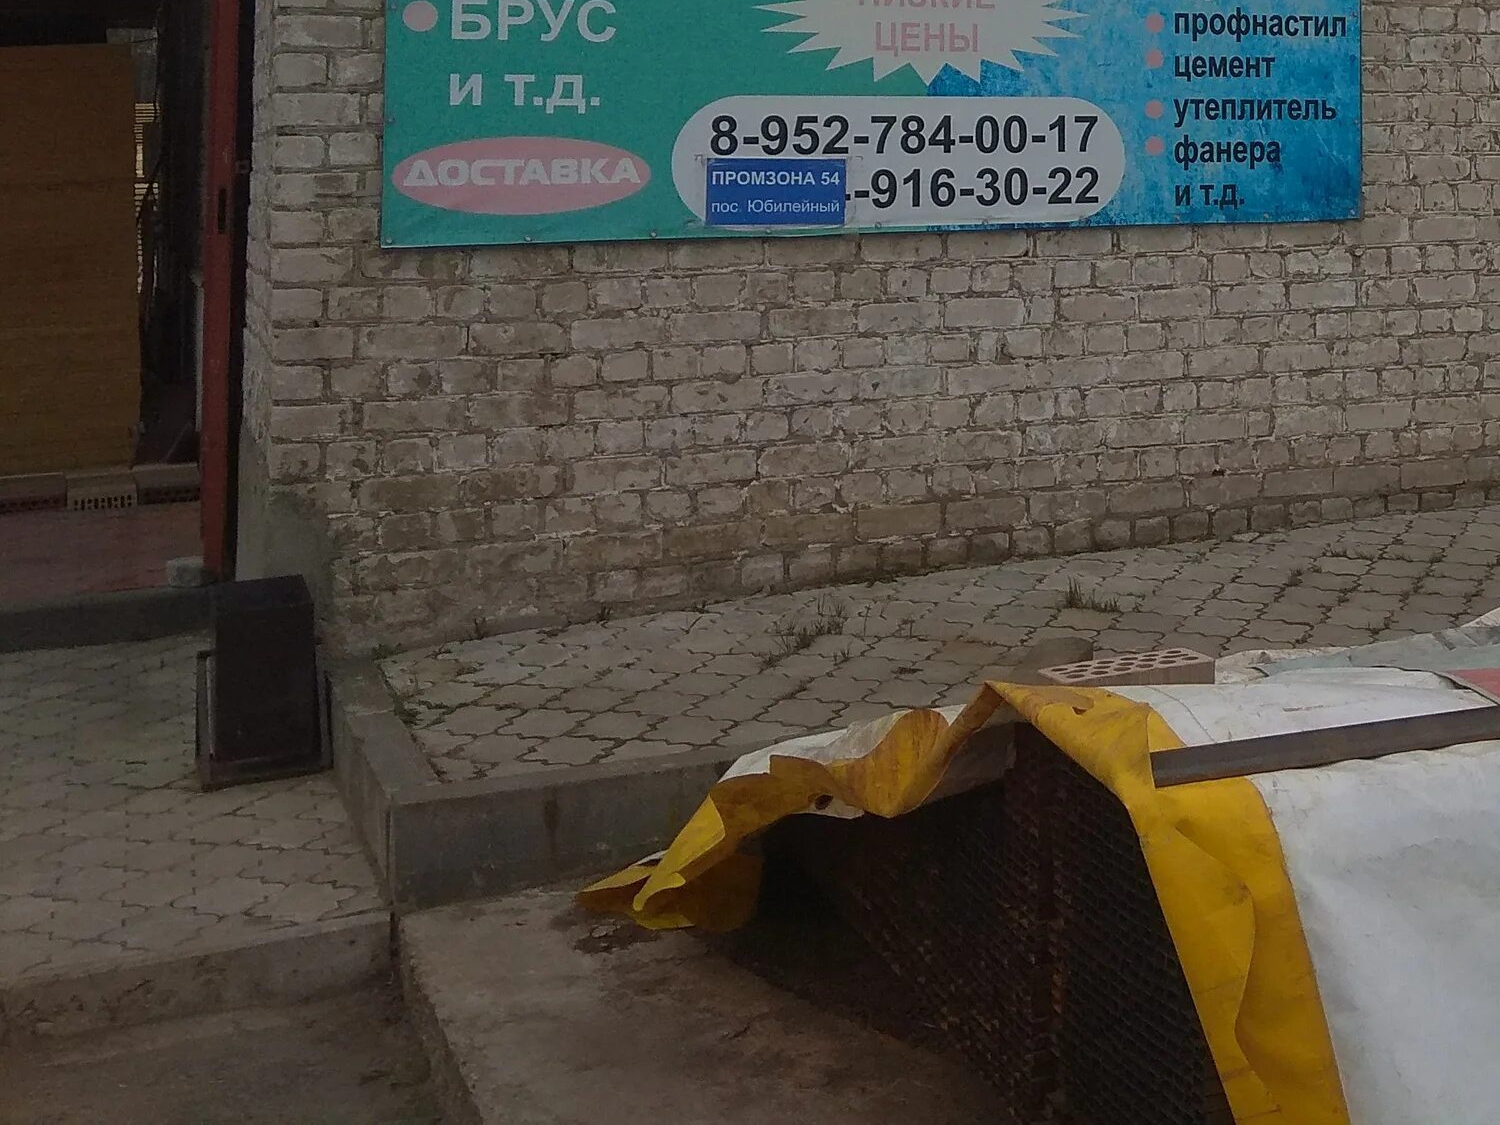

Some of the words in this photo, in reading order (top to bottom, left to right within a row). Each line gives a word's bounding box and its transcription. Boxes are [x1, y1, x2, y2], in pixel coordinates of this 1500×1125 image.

[875, 21, 979, 58] ЦЕНЫ
[1173, 11, 1347, 39] профнастил
[1173, 53, 1276, 81] цемент
[449, 73, 483, 106] и
[504, 74, 601, 114] т.д.
[1173, 95, 1337, 127] утеплитель
[709, 114, 1099, 156] 8-952-784-00-17
[1173, 138, 1282, 174] фанера
[402, 158, 642, 187] ДОСТАВКА
[711, 171, 816, 186] ПРОМЗОНА
[821, 171, 841, 186] 54
[845, 166, 1100, 209] -916-30-22
[747, 199, 841, 213] Юбилейный
[1175, 186, 1191, 206] и
[1202, 185, 1246, 210] т.д.
